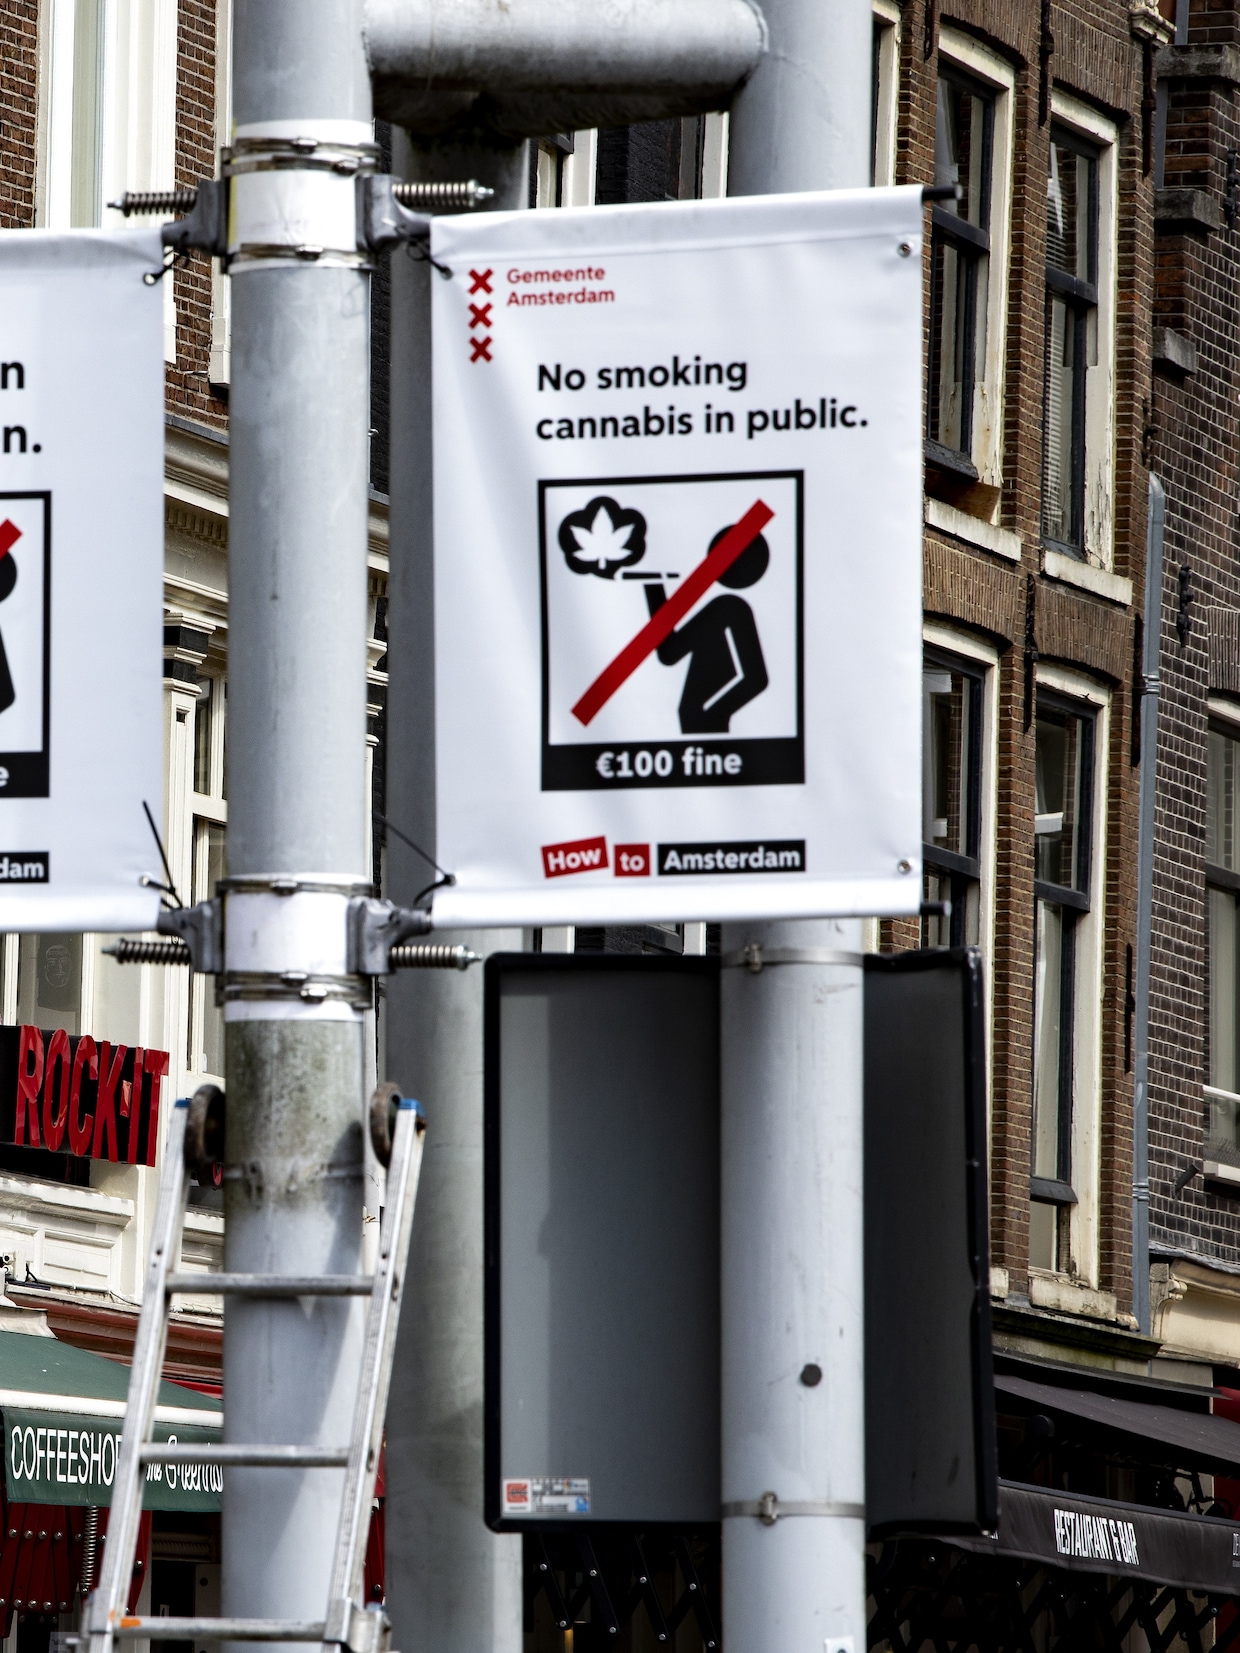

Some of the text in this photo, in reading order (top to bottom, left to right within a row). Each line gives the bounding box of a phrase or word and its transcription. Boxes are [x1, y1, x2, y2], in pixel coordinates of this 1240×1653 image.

[506, 265, 606, 284] Gemeente
[506, 287, 616, 307] Amsterdam
[536, 355, 748, 392] No smoking
[536, 398, 869, 440] cannabis in public.
[596, 747, 743, 779] €100 fine
[546, 845, 801, 872] How to Amsterdam
[15, 1024, 170, 1168] ROCK-IT
[1053, 1508, 1114, 1561] RESTAURANT
[1116, 1520, 1140, 1566] BAR
